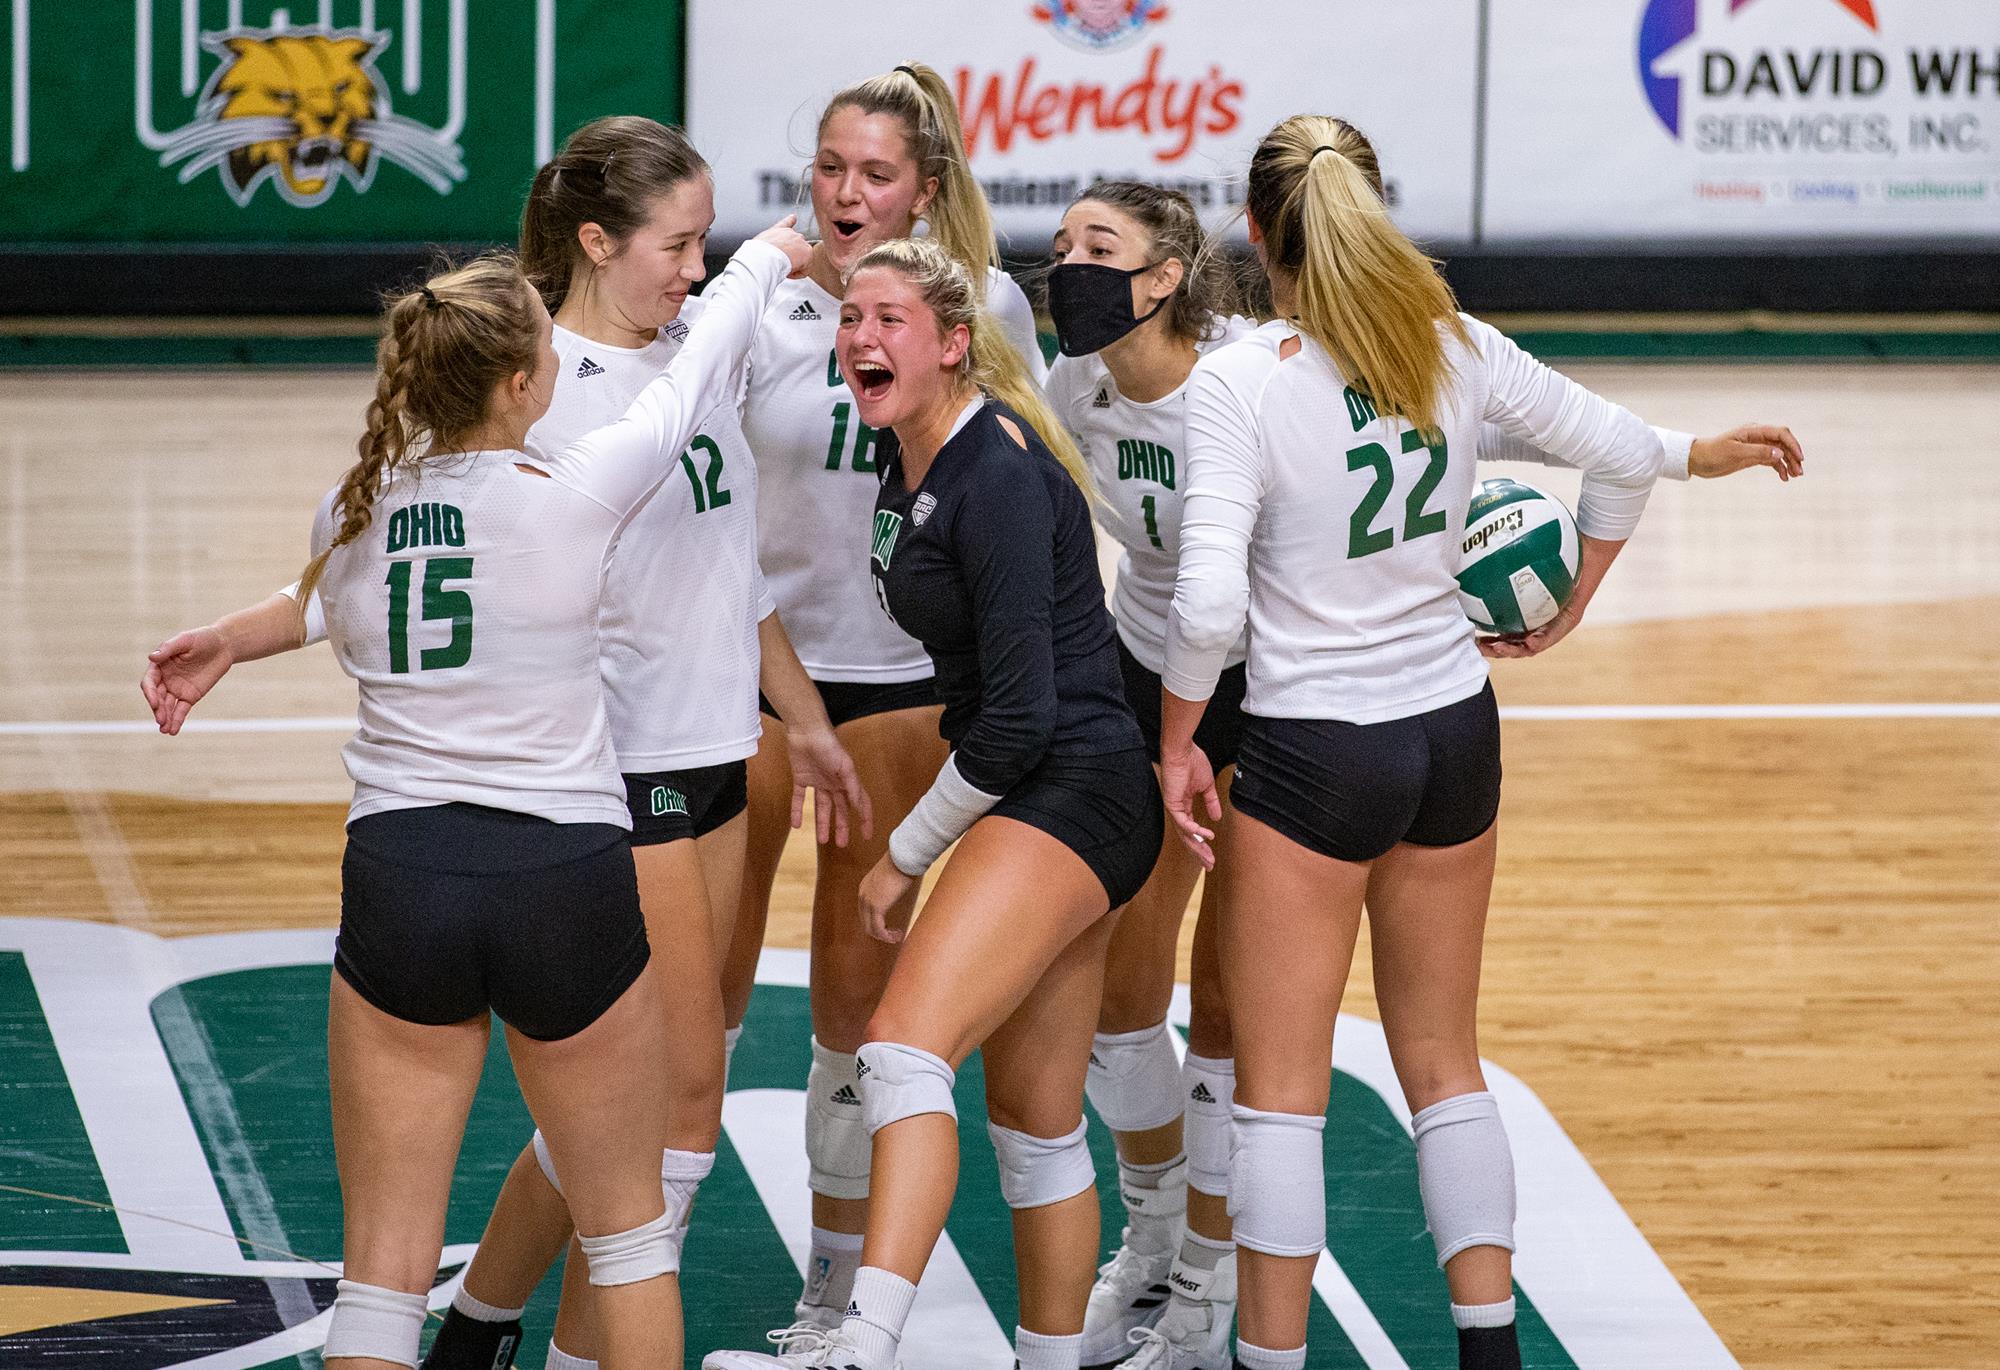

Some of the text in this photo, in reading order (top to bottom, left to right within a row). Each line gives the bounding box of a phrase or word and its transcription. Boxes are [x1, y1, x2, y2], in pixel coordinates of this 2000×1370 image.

[1703, 52, 2000, 96] DAVID WH
[955, 44, 1242, 161] Wendy's
[1698, 115, 1897, 155] SERVICES,
[789, 312, 822, 321] adidas
[577, 366, 605, 379] adidas
[681, 434, 731, 514] 12
[1117, 439, 1176, 491] OHIO
[1345, 424, 1448, 560] 22
[387, 502, 465, 554] OHIO
[1141, 495, 1165, 552] 1
[1461, 508, 1523, 554] Baden
[384, 557, 474, 674] 15
